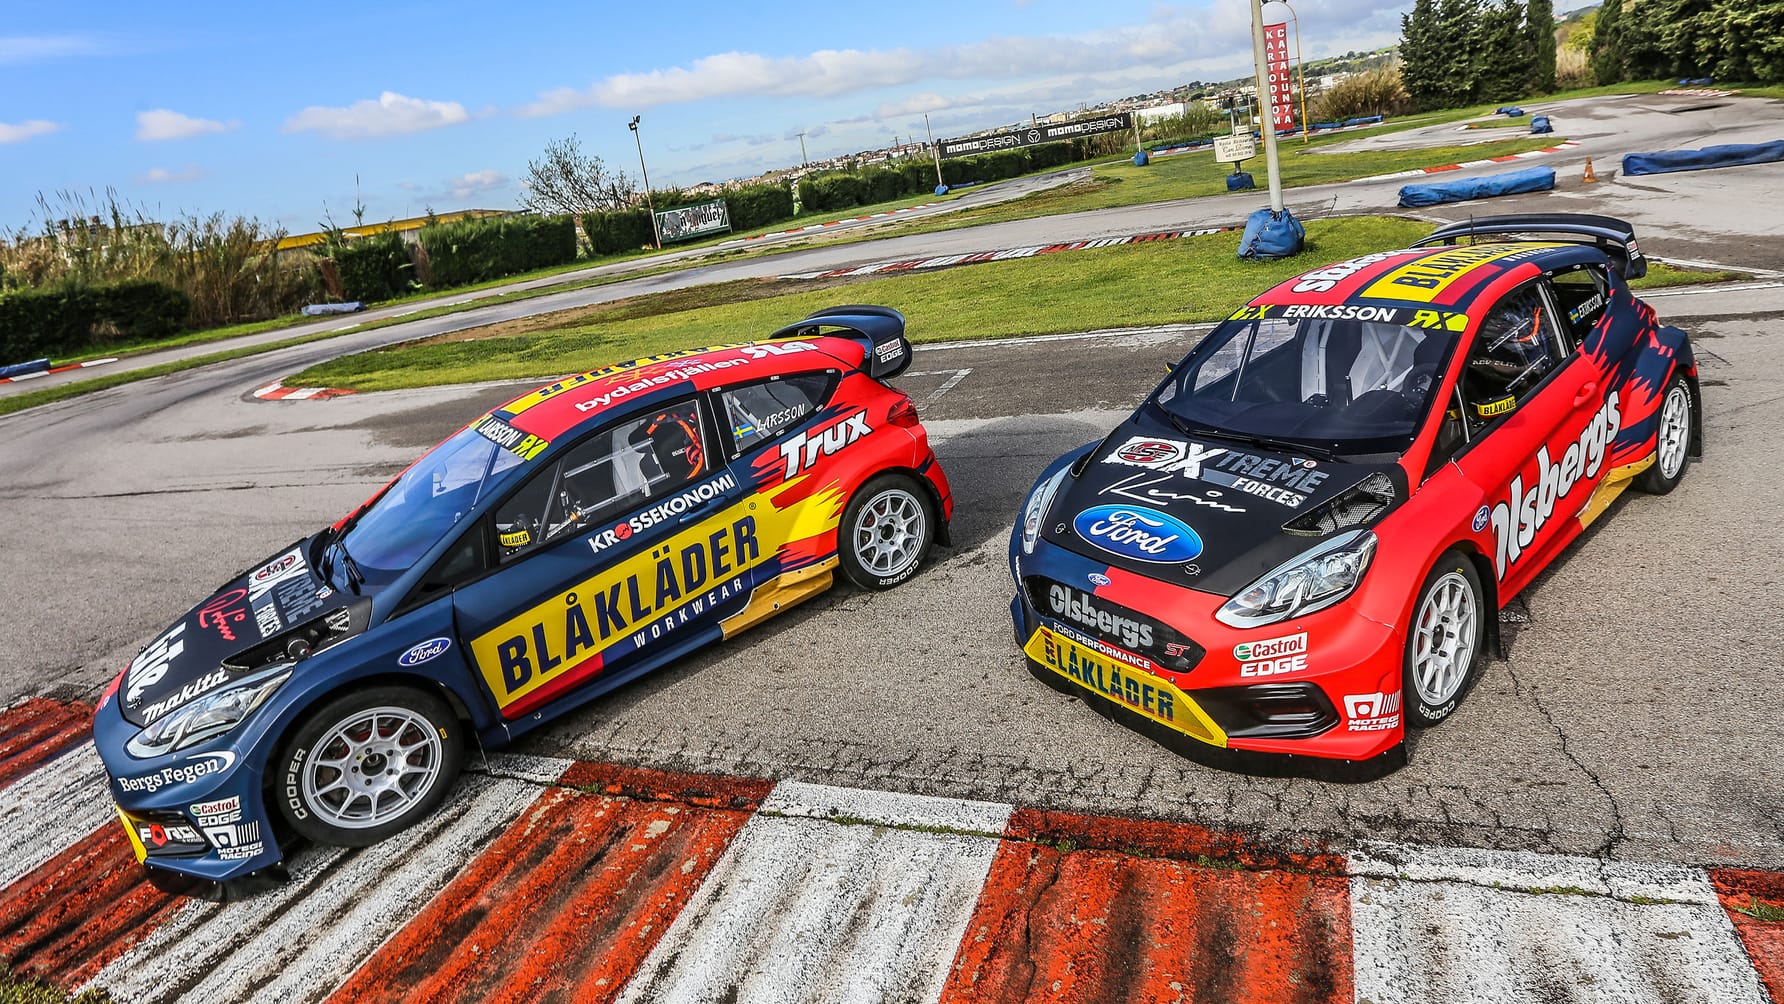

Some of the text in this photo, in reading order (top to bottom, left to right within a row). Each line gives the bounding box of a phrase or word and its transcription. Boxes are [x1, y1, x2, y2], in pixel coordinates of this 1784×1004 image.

[1265, 30, 1280, 125] KARTODROM
[1277, 29, 1292, 124] CATALUNYA
[1282, 304, 1398, 322] ERIKSSON
[1577, 293, 1603, 319] ERIKSSON
[880, 348, 904, 363] EDGE
[575, 357, 750, 412] bydalsfjällen
[755, 403, 805, 433] LARSSON
[478, 418, 522, 447] LARSSON
[780, 409, 874, 480] Trux
[1230, 476, 1306, 508] FORCES
[587, 473, 736, 554] KROSSEKONOMI
[1474, 507, 1489, 530] Ford
[1090, 510, 1179, 554] Ford
[879, 559, 919, 586] COOPER
[1089, 574, 1110, 585] Ford
[496, 515, 760, 695] BLÅKLÄDER
[633, 577, 743, 649] WORKWEAR
[1050, 584, 1154, 649] Olsbergs
[407, 640, 444, 664] Ford
[1053, 622, 1151, 669] FORD PERFORMANCE
[1252, 636, 1304, 658] Castrol
[1044, 636, 1175, 722] BLÅKLÄDER
[1240, 653, 1308, 678] EDGE
[142, 667, 230, 725] makita
[1348, 714, 1400, 726] MOTEGI
[1419, 702, 1456, 720] COOPER
[1347, 721, 1399, 732] RACING
[286, 748, 308, 820] COOPER
[198, 809, 243, 827] EDGE
[201, 798, 239, 815] Castrol
[217, 841, 264, 855] MOTEGI
[220, 847, 265, 861] RACING
